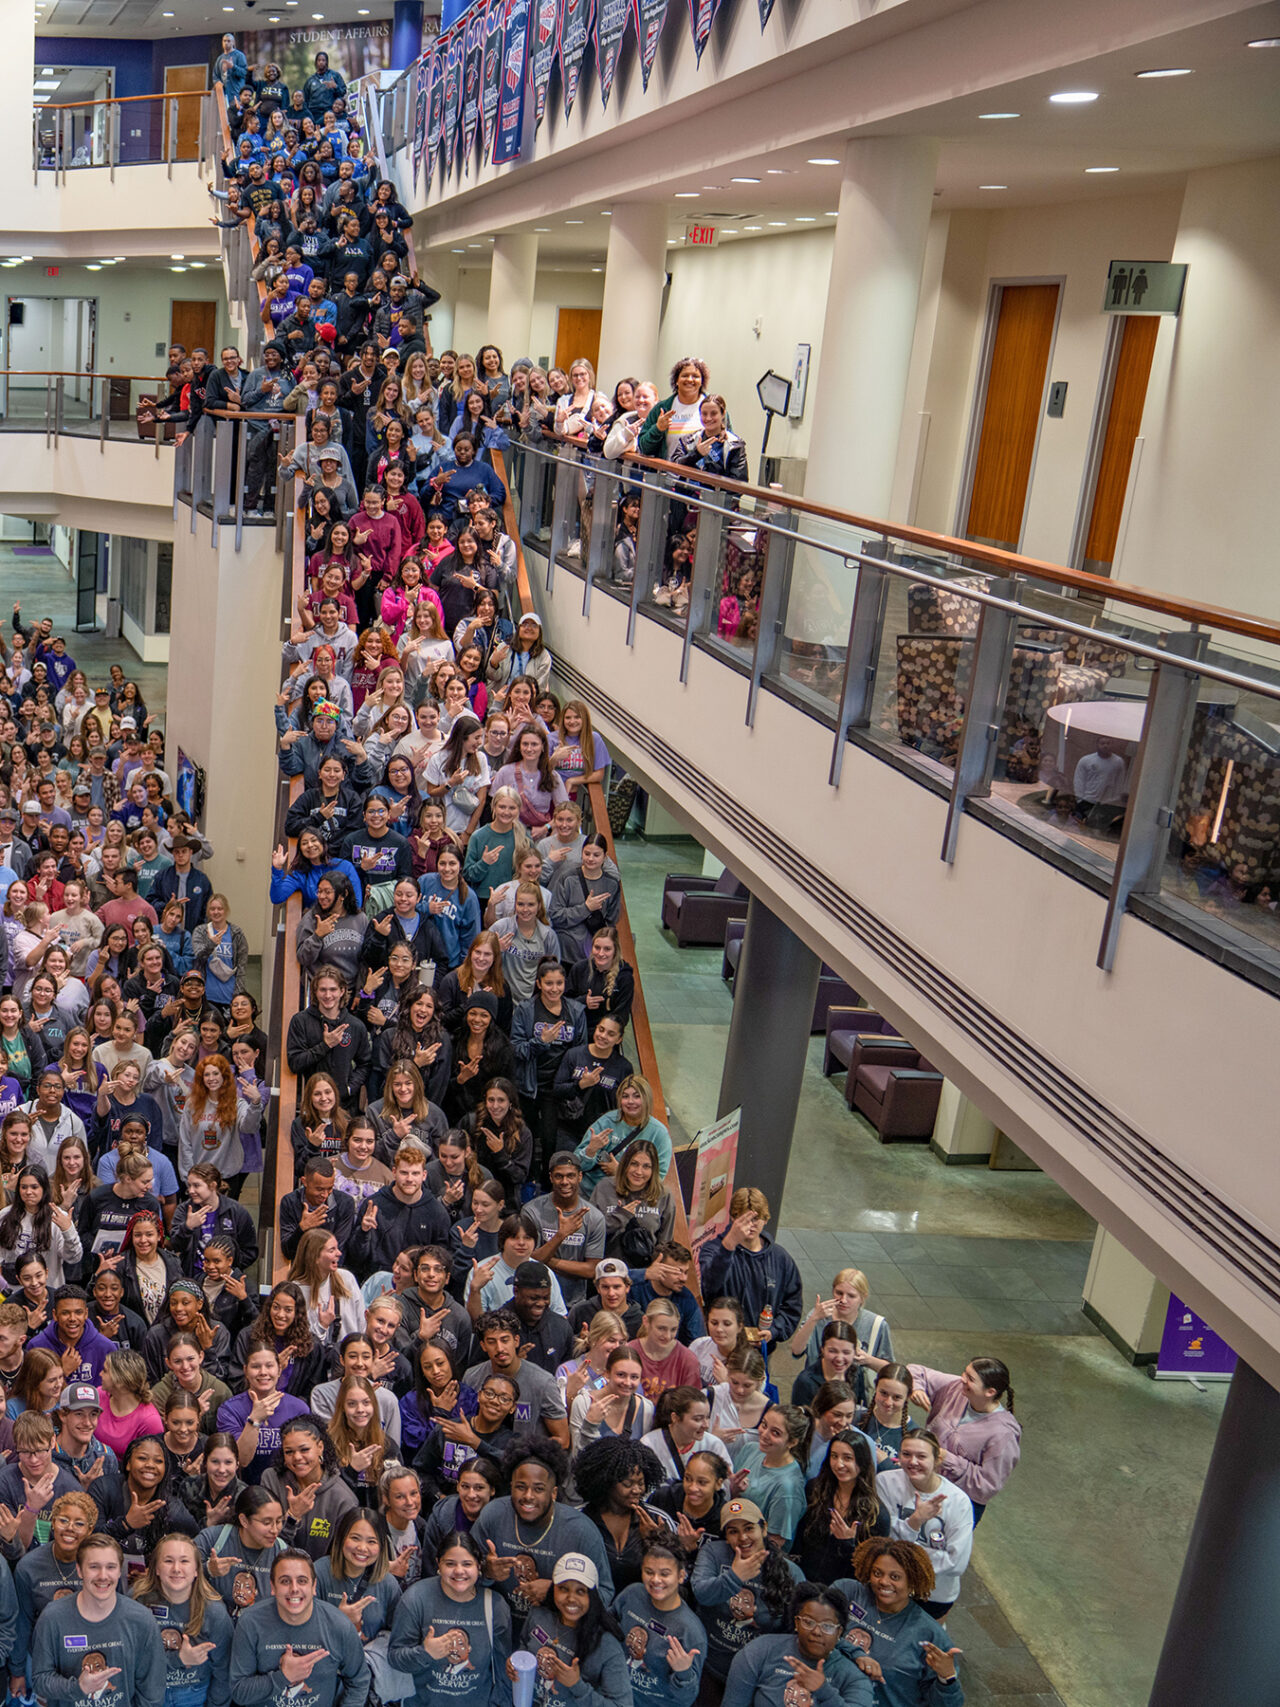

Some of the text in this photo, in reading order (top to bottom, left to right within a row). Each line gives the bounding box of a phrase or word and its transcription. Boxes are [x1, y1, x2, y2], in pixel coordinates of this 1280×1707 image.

[290, 25, 389, 45] STUDENT AFFAIRS
[693, 227, 715, 244] EXIT
